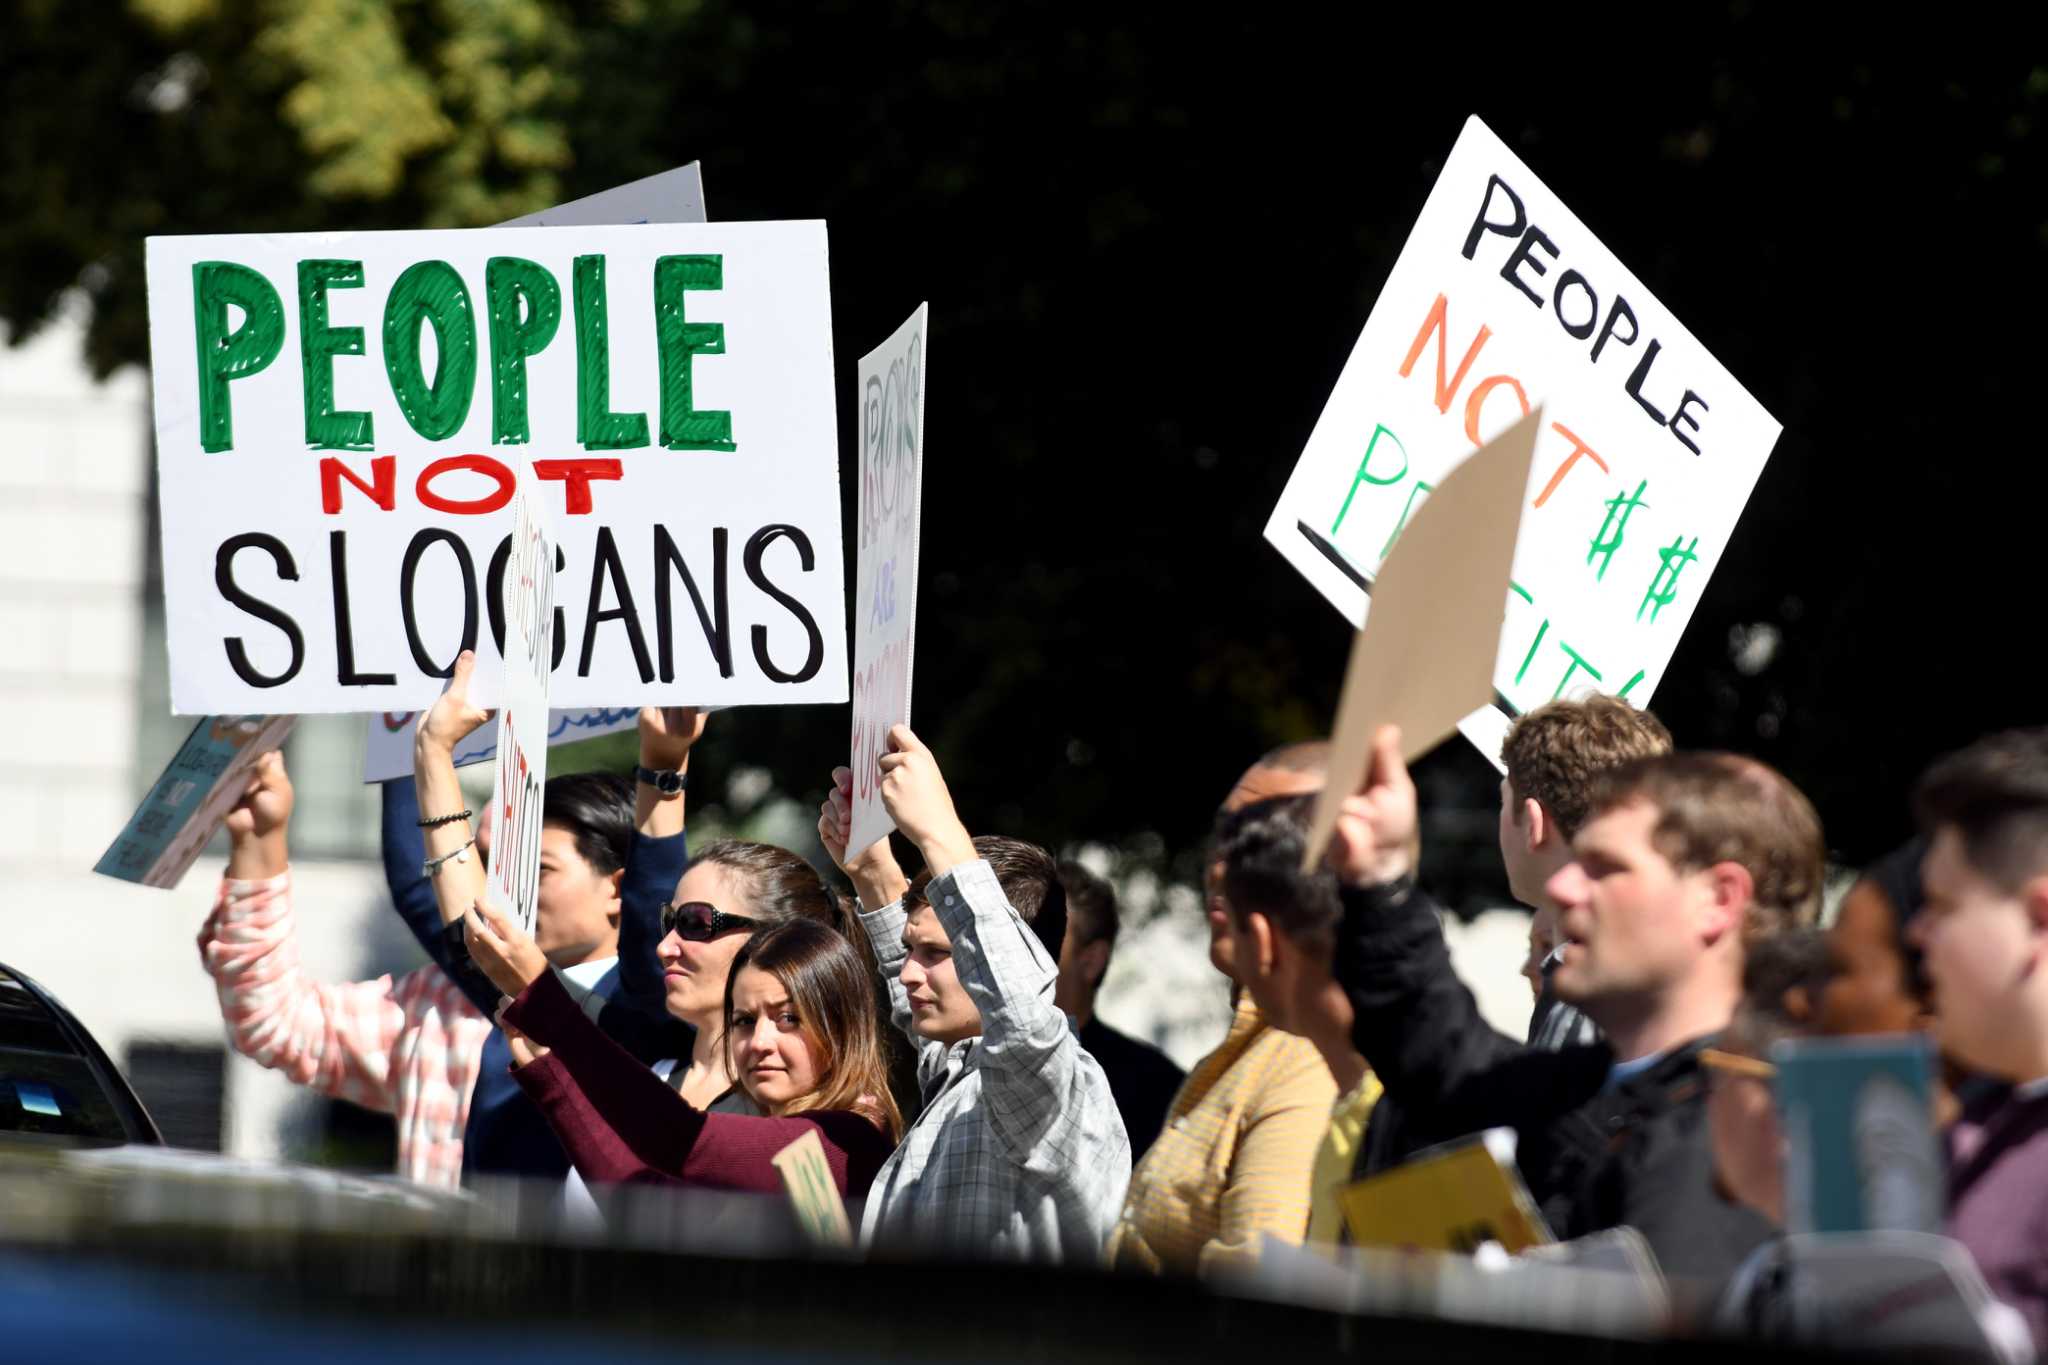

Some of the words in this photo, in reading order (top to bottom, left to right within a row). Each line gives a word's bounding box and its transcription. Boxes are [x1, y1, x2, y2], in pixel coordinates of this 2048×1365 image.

[192, 253, 738, 453] PEOPLE
[1398, 292, 1610, 509] NOT
[1461, 173, 1709, 456] PEOPLE
[319, 453, 624, 515] NOT
[214, 522, 825, 688] SLOGANS
